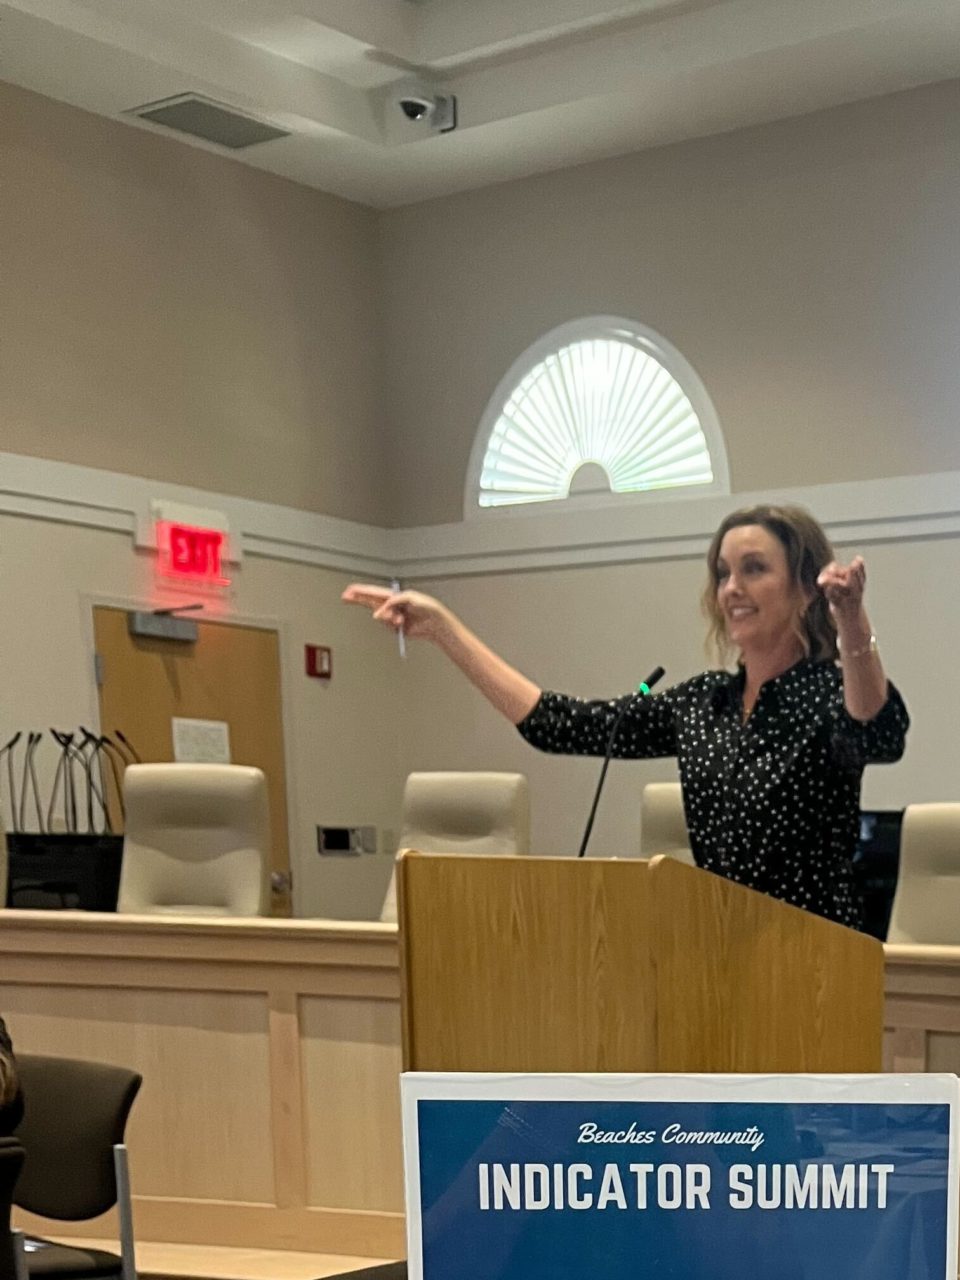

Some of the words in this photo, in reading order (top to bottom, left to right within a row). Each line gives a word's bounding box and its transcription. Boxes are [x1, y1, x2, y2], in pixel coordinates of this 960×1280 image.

[169, 527, 222, 574] EXIT
[577, 1123, 656, 1145] Beaches
[662, 1123, 765, 1152] Community
[478, 1163, 711, 1210] INDICATOR
[728, 1163, 895, 1210] SUMMIT
